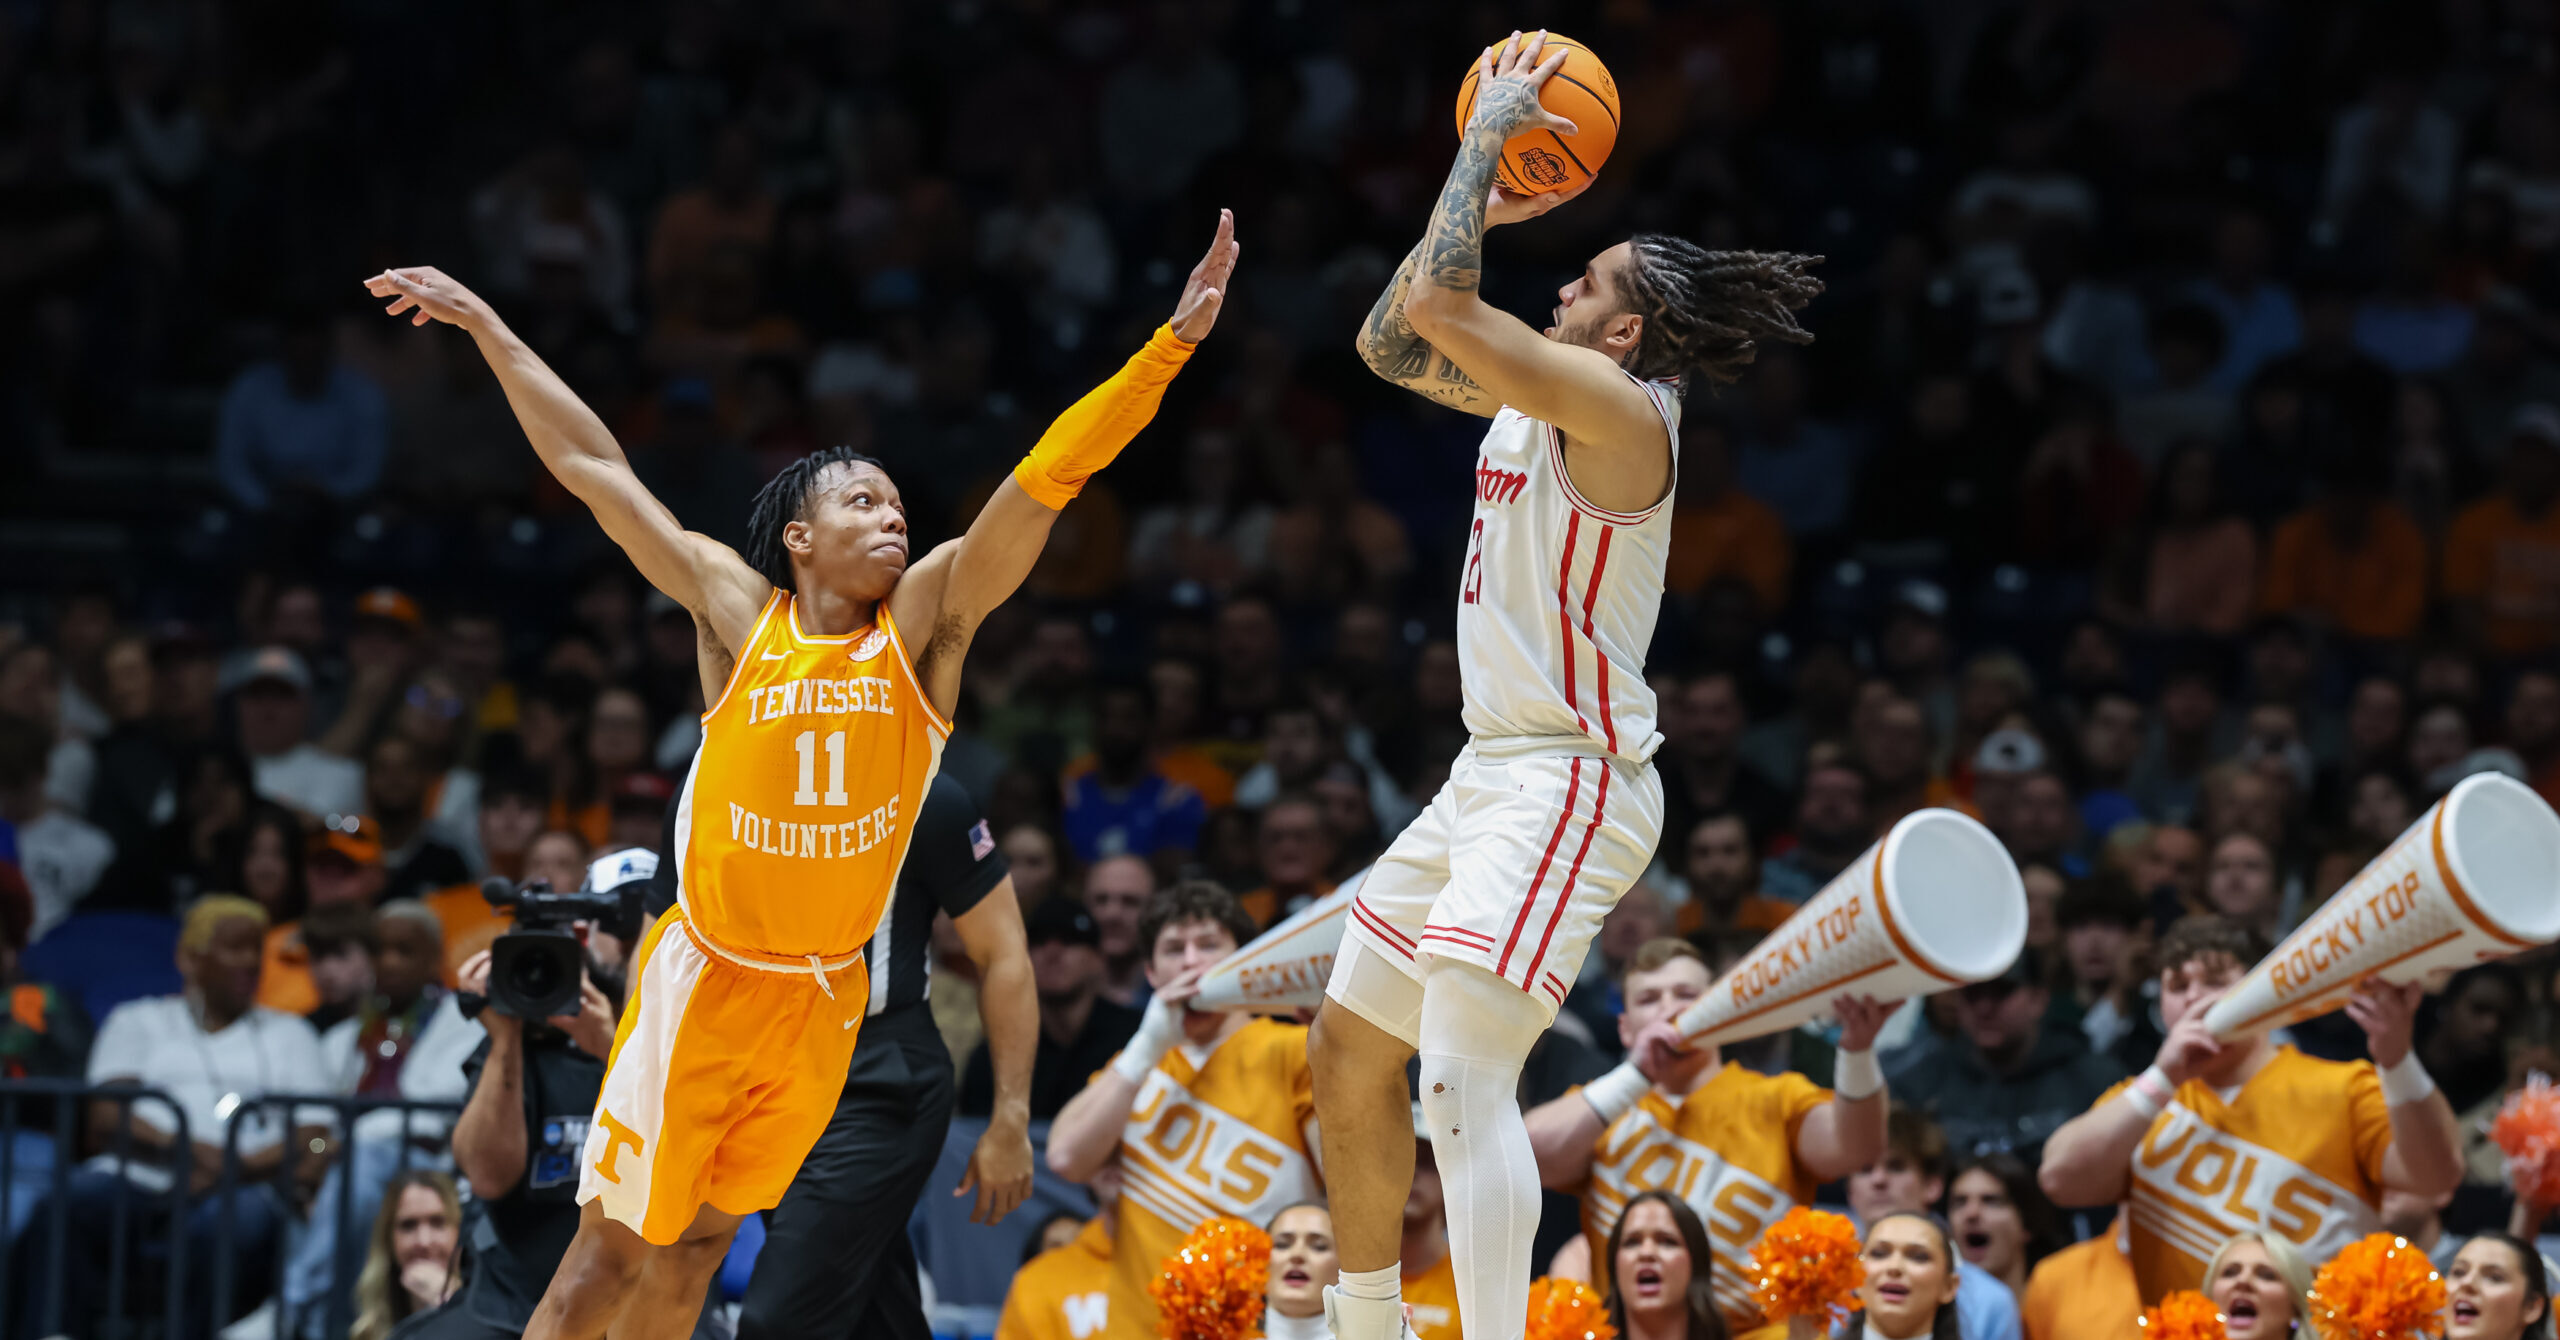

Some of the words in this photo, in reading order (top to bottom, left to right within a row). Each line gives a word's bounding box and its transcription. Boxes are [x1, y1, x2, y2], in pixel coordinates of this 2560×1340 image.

[1530, 163, 1555, 187] MARCH
[1476, 455, 1527, 504] ton
[748, 676, 894, 725] TENNESSEE
[794, 731, 848, 805] 11
[729, 794, 899, 859] VOLUNTEERS
[1731, 928, 1811, 1008] ROCKY
[1816, 896, 1861, 950] TOP
[2270, 909, 2365, 998] ROCKY
[2366, 870, 2419, 930] TOP
[1238, 959, 1311, 1001] ROCKY
[1309, 953, 1336, 990] TO
[594, 1107, 645, 1185] T
[2141, 1110, 2333, 1244] VOLS
